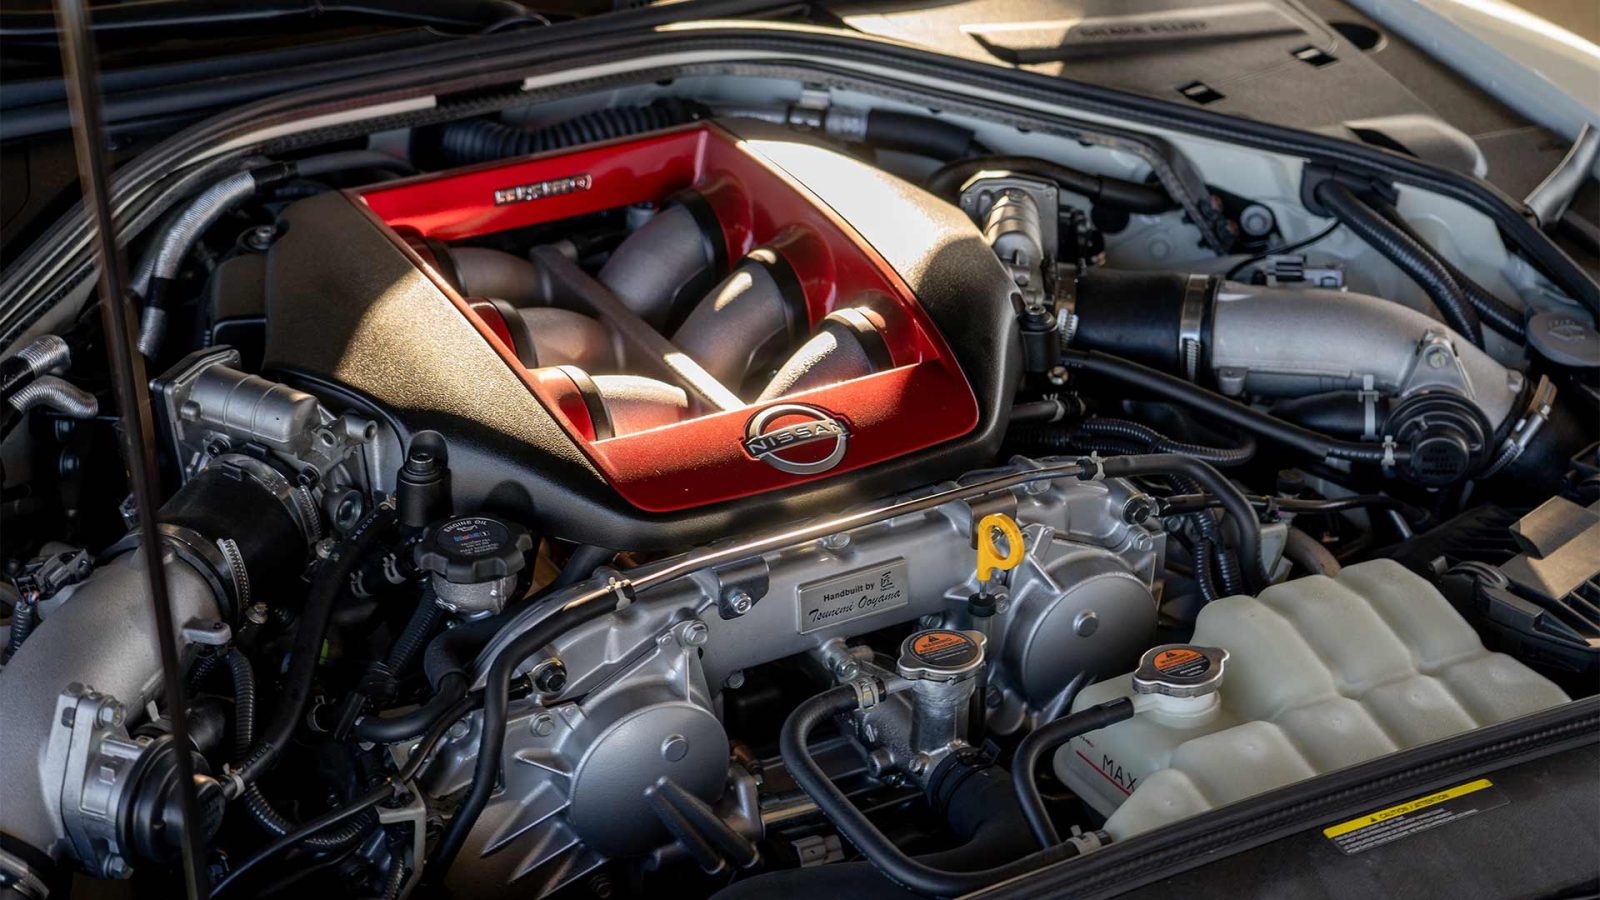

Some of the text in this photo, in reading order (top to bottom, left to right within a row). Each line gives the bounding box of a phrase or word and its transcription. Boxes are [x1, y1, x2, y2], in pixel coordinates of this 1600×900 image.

[748, 421, 843, 454] NISSAN
[443, 519, 472, 533] ENGINE
[808, 589, 901, 623] Tsunemi Ooyama
[823, 582, 875, 602] Handbuilt by
[1102, 753, 1137, 792] MAX
[1379, 805, 1409, 819] CAUTION
[1414, 793, 1450, 810] ATTENTION
